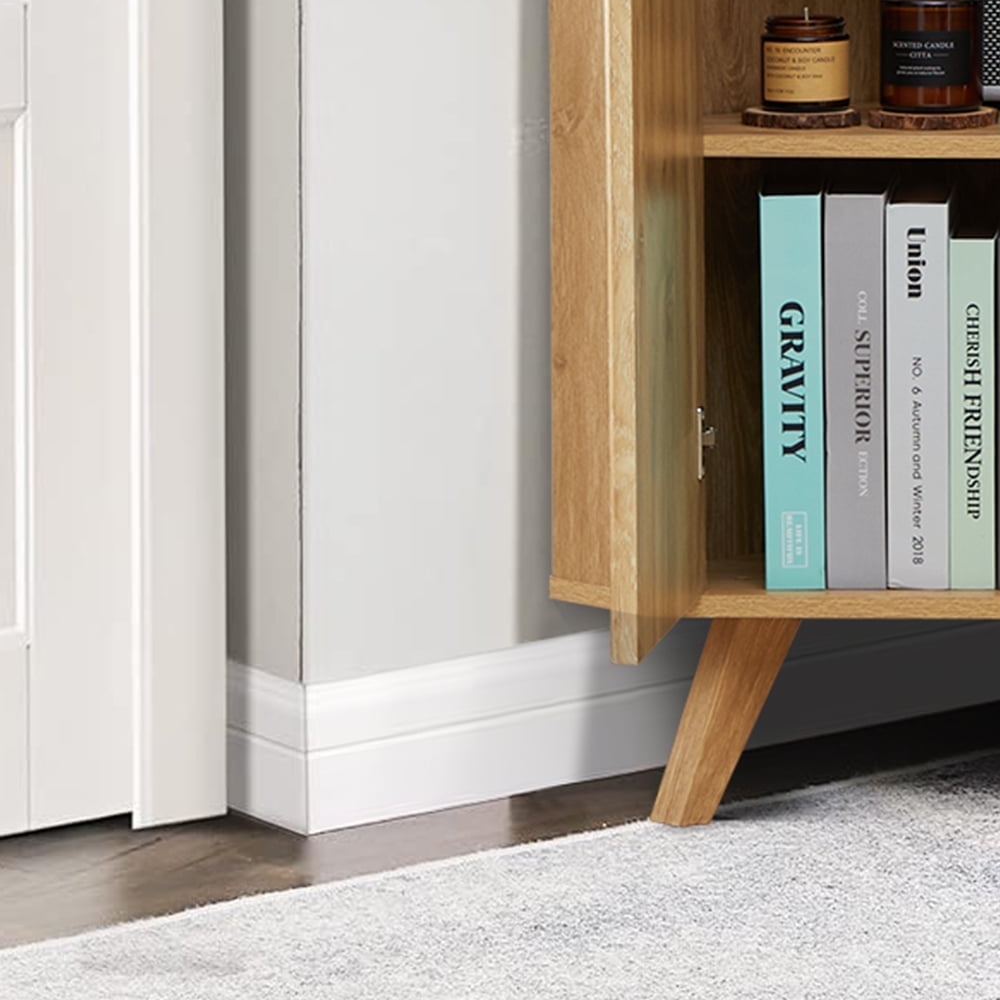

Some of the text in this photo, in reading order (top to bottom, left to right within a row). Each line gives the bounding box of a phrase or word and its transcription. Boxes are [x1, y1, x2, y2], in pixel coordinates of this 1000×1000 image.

[924, 41, 955, 50] CANDLE
[858, 290, 868, 325] COLL
[907, 227, 926, 299] Union
[779, 301, 807, 464] GRAVITY
[854, 328, 871, 444] SUPERIOR
[963, 303, 983, 520] CHERISH FRIENDSHIP
[858, 451, 869, 497] ECTION
[911, 356, 924, 566] NO. 6 Autumn and Winter 2018
